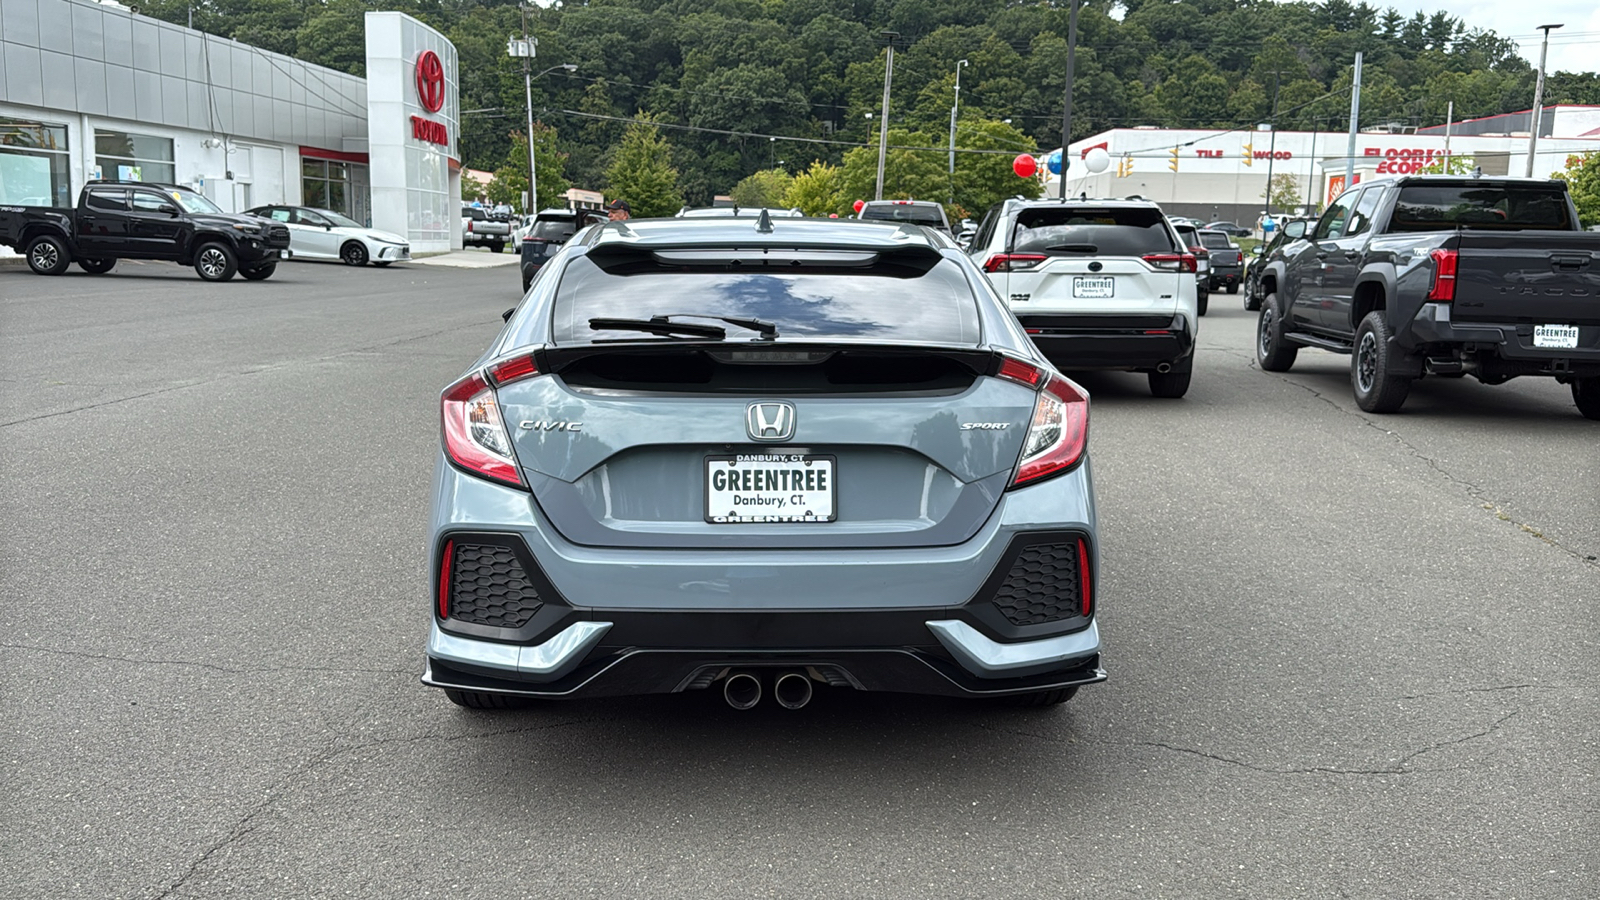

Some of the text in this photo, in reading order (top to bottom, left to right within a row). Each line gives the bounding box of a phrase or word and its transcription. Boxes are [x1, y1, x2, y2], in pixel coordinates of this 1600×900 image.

[410, 115, 448, 146] TOYOTA
[1196, 150, 1292, 160] TILE WOOD
[1376, 161, 1425, 174] ECOR
[1536, 328, 1576, 338] GREENTREE
[519, 420, 583, 432] CIVIC
[960, 422, 1010, 430] SPORT
[736, 454, 804, 463] DANBURY, CT
[713, 469, 827, 491] GREENTREE
[734, 494, 806, 508] Danbury, CT.
[713, 515, 829, 523] GREENTREE
